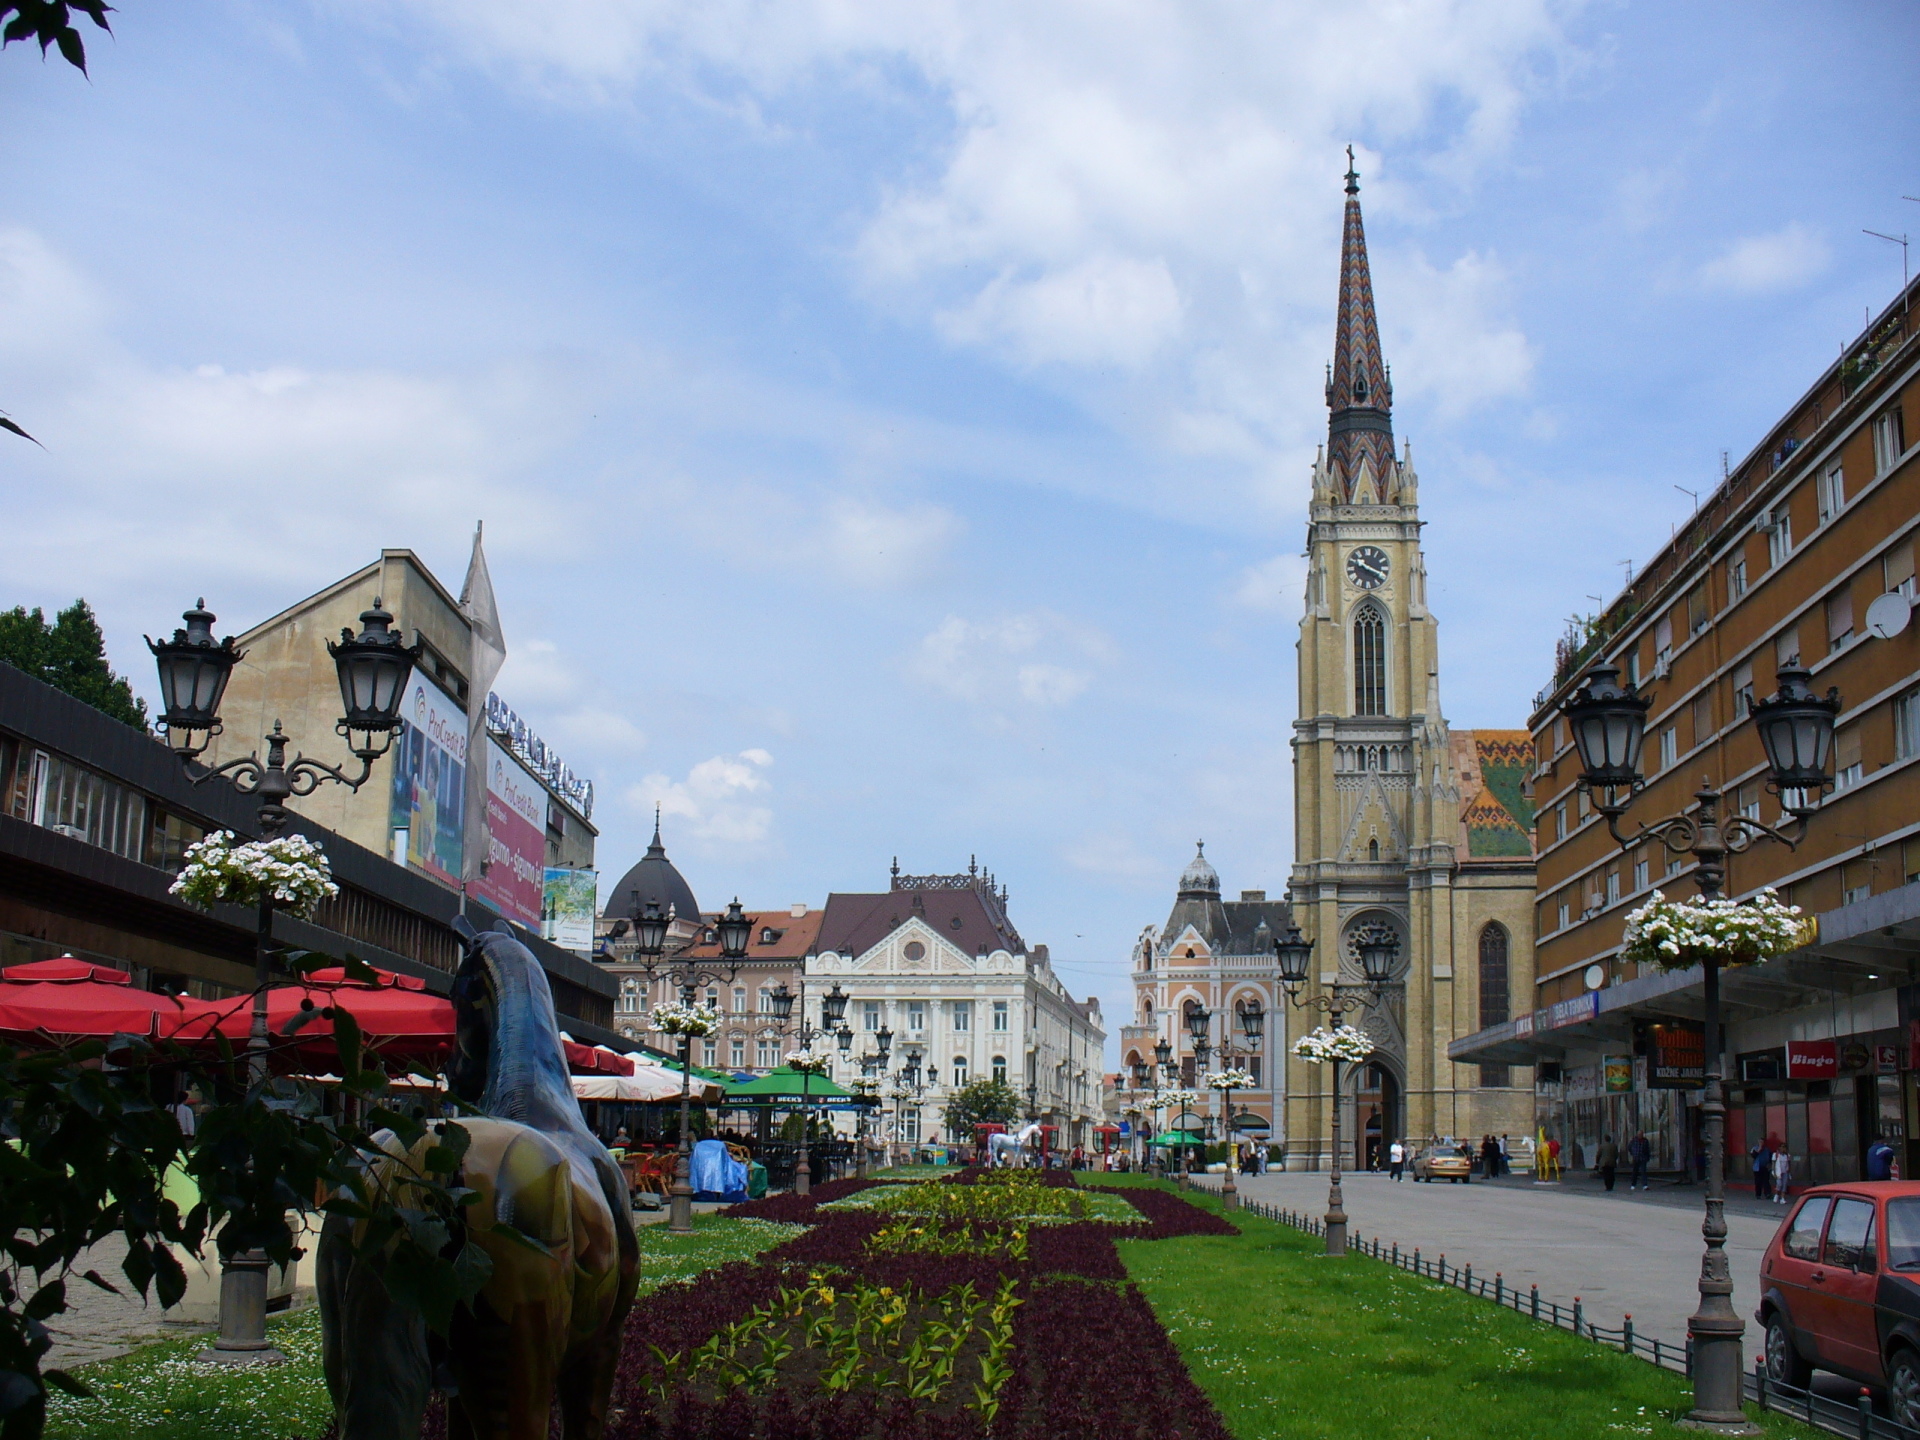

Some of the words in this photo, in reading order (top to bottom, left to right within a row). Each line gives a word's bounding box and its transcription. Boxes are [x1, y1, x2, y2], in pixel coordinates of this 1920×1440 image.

[428, 708, 459, 755] ProCredit
[504, 777, 527, 815] ProCredit
[527, 795, 540, 823] Bank
[1656, 1029, 1704, 1050] Rolling
[1791, 1054, 1834, 1067] Bingo
[1681, 1067, 1704, 1078] JAKNE
[777, 1095, 802, 1103] BECK'S
